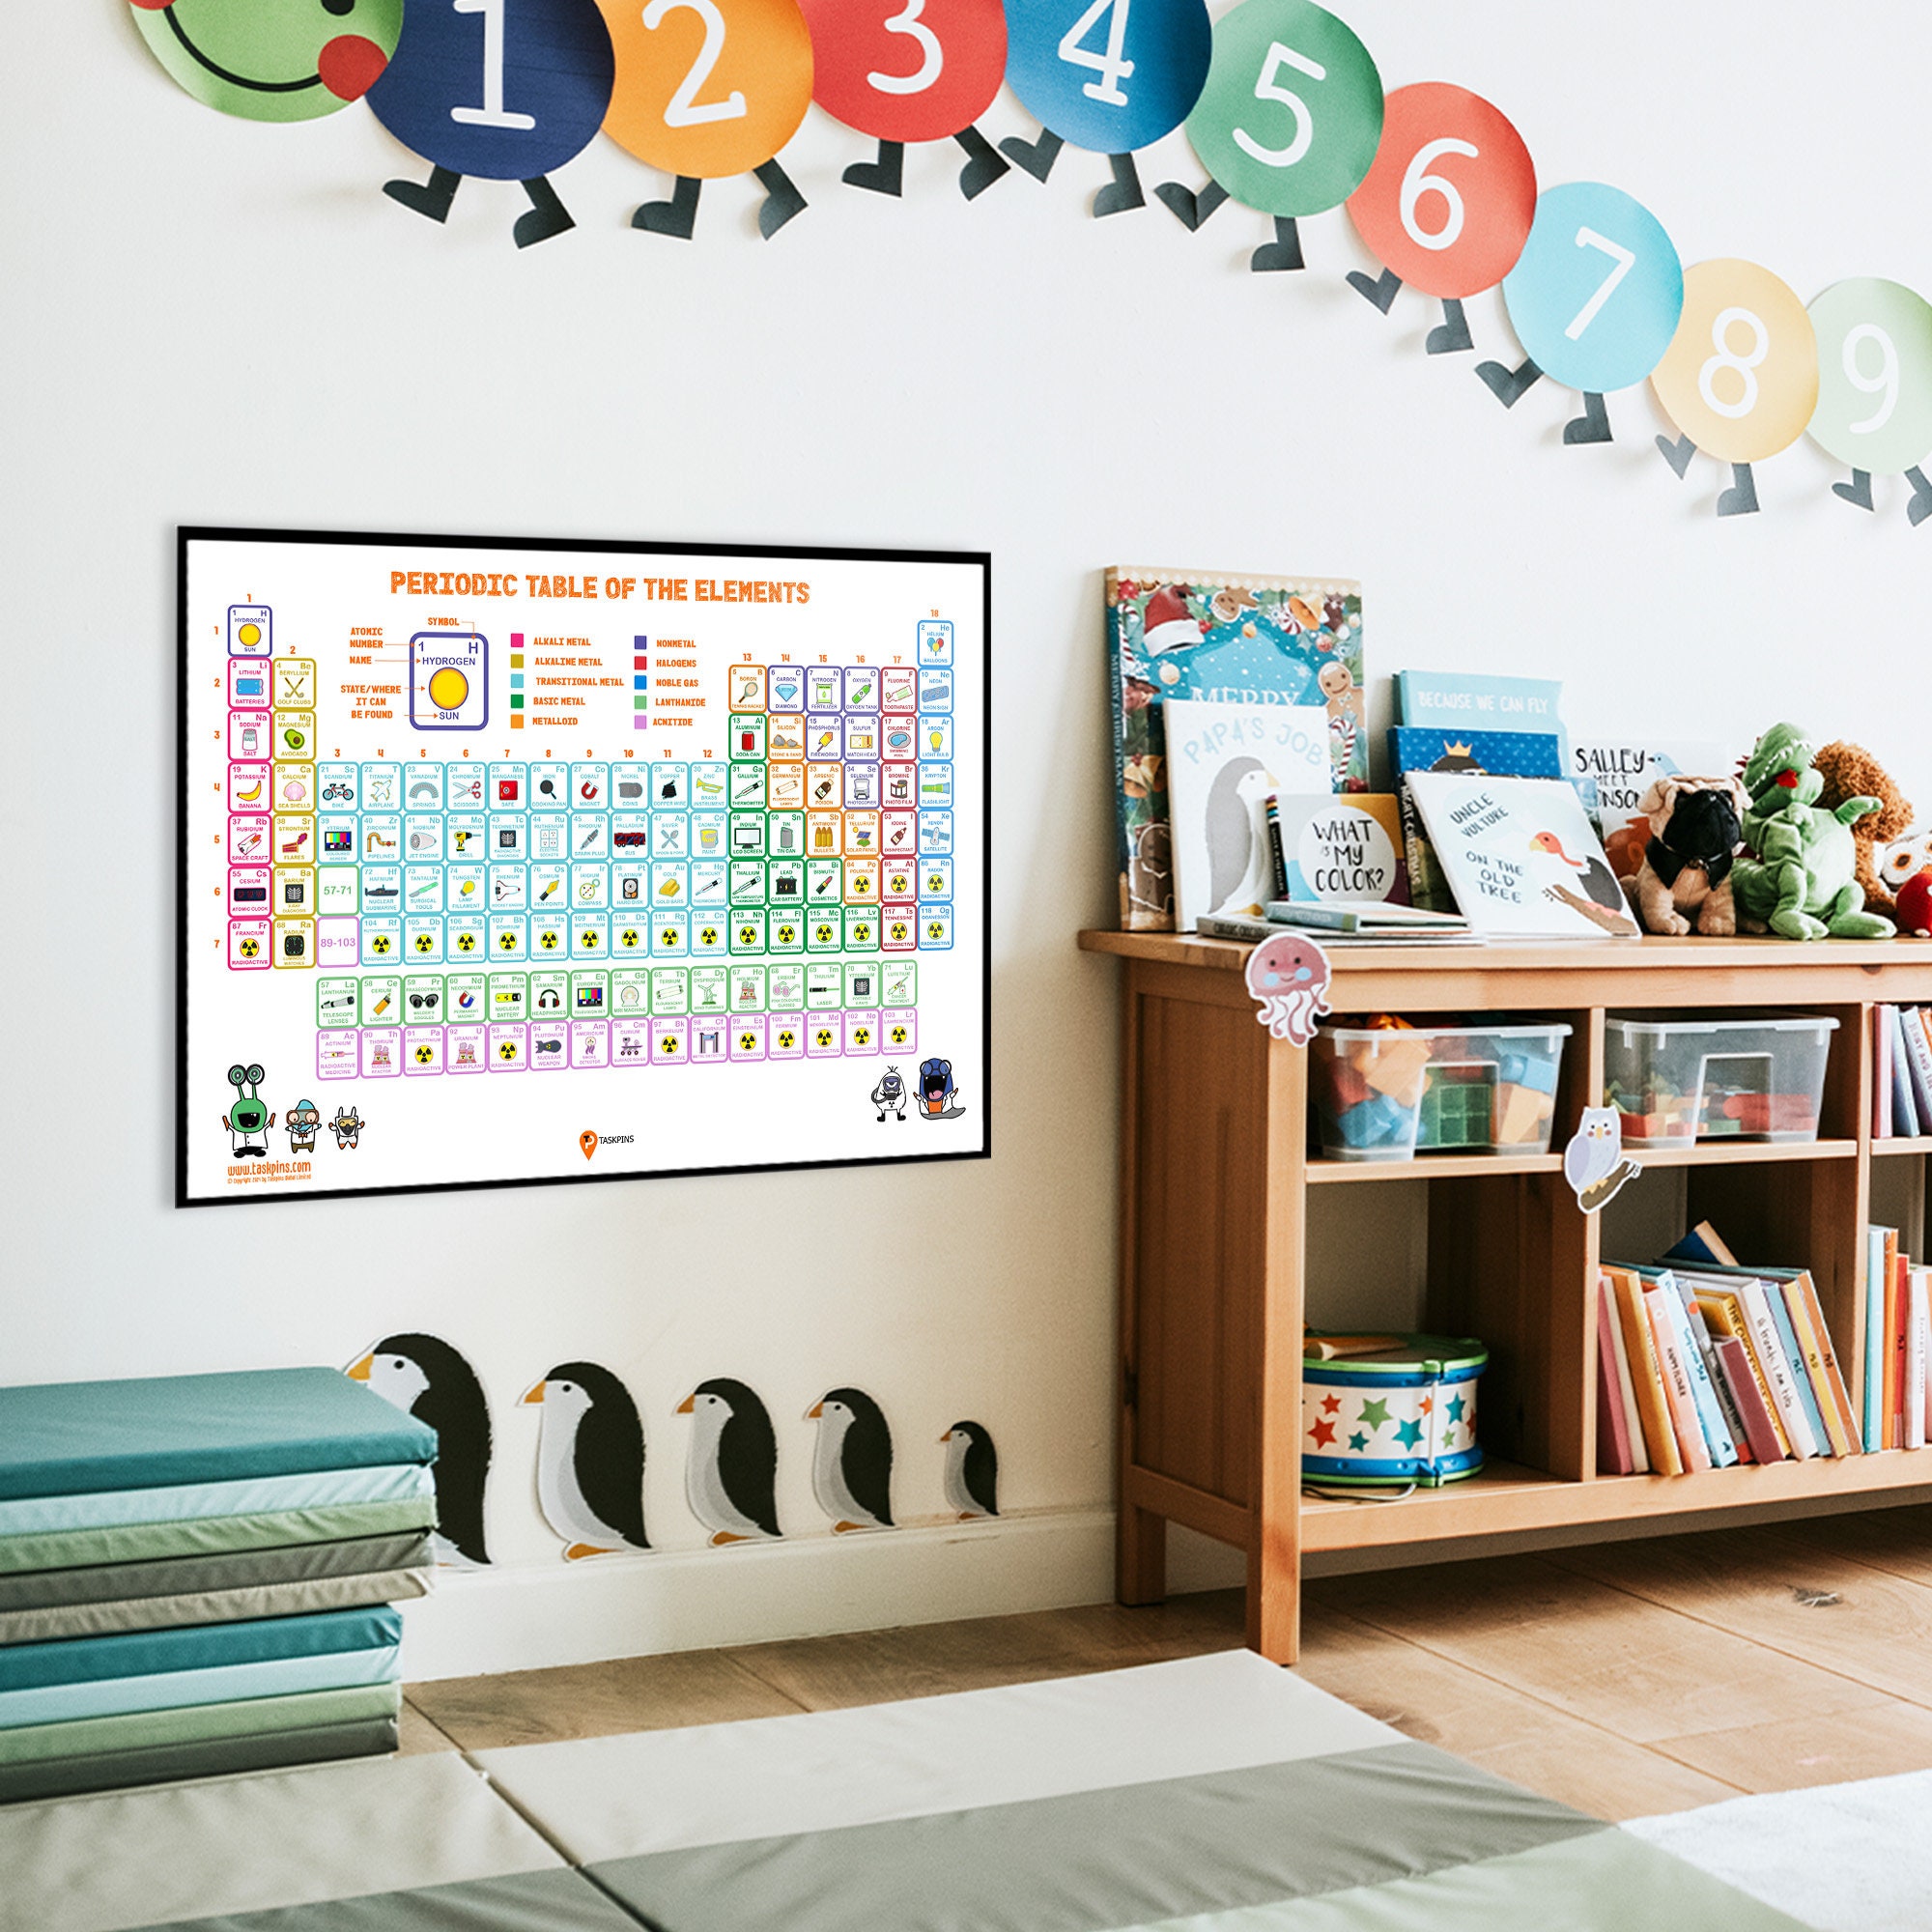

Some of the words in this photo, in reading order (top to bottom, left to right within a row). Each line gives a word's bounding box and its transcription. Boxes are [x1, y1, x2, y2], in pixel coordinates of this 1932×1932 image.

[867, 0, 943, 95] 3
[1059, 0, 1135, 106] 4
[451, 0, 535, 129] 1
[641, 0, 747, 127] 2
[1233, 41, 1326, 166] 5
[1400, 138, 1479, 250] 6
[1565, 226, 1635, 341] 7
[1699, 307, 1769, 418] 8
[1842, 324, 1899, 434] 9
[391, 571, 518, 596] PERIODIC
[526, 575, 597, 599] TABLE
[605, 577, 636, 599] OF
[643, 578, 688, 601] THE
[696, 580, 810, 604] ELEMENTS
[247, 593, 251, 603] 1
[428, 617, 460, 626] SYMBOL
[214, 626, 218, 635] 1
[351, 627, 383, 636] ATOMIC
[350, 639, 383, 648] NUMBER
[566, 638, 591, 646] METAL
[657, 639, 696, 648] NONMETAL
[290, 645, 296, 654] 2
[418, 641, 423, 652] 1
[469, 641, 478, 654] H
[350, 656, 372, 665] NAME
[422, 657, 475, 668] HYDROGEN
[535, 657, 576, 666] ALKALINE
[580, 658, 603, 667] METAL
[657, 659, 696, 668] HALOGENS
[819, 654, 827, 663] 15
[214, 678, 220, 687] 2
[536, 677, 597, 686] TRANSITIONAL
[341, 685, 401, 694] STATE/WHERE
[533, 696, 558, 705] BASIC
[1190, 686, 1300, 705] MERRY
[356, 697, 365, 706] IT
[368, 697, 386, 706] CAN
[1417, 692, 1472, 709] BECAUSE
[1477, 696, 1495, 711] WE
[1500, 696, 1523, 712] CAN
[1528, 697, 1548, 713] FLY
[352, 710, 362, 719] BE
[365, 710, 392, 719] FOUND
[440, 709, 459, 720] SUN
[532, 717, 578, 725] METALLOID
[653, 718, 693, 726] ACNITIDE
[214, 730, 220, 739] 3
[1183, 717, 1264, 764] PAPA'S
[1277, 724, 1323, 765] JOB
[334, 749, 340, 757] 3
[378, 749, 384, 757] 4
[420, 749, 426, 757] 5
[1576, 748, 1644, 773] SALLEY
[1450, 793, 1493, 824] UNCLE
[1462, 806, 1509, 838] VULTURE
[1313, 820, 1372, 841] WHAT
[214, 835, 219, 843] 5
[1466, 850, 1488, 865] ON
[1494, 859, 1523, 876] THE
[1316, 868, 1383, 891] COLOR?
[1481, 869, 1515, 887] OLD
[214, 887, 220, 896] 6
[324, 886, 351, 895] 57-71
[1477, 881, 1521, 903] TREE
[214, 940, 219, 949] 7
[321, 938, 355, 948] 89-103
[599, 1135, 634, 1144] TASKPINS
[228, 1160, 311, 1177] www.taskpins.com
